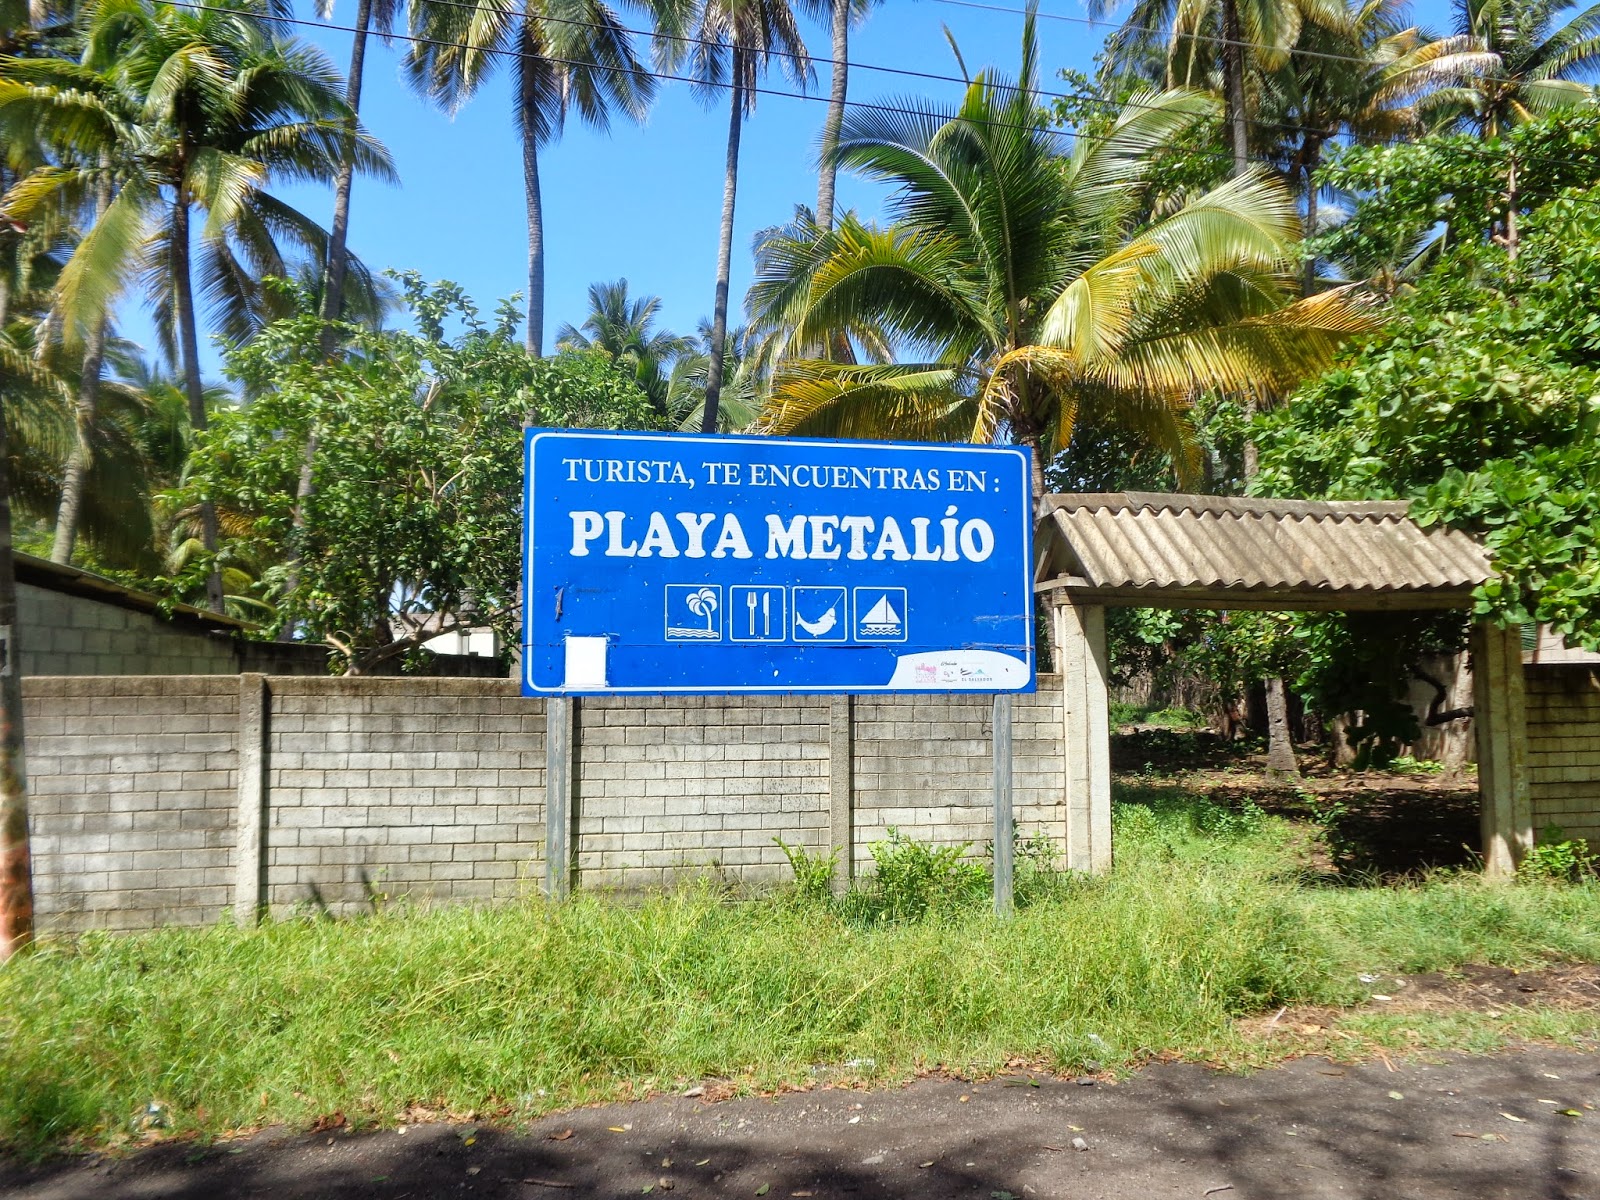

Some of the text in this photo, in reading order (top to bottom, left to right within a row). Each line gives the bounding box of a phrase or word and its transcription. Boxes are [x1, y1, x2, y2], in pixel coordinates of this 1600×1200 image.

[562, 458, 695, 490] TURISTA,
[702, 462, 741, 486] TE
[749, 464, 941, 491] ENCUENTRAS
[568, 504, 995, 563] PLAYA METALÍO
